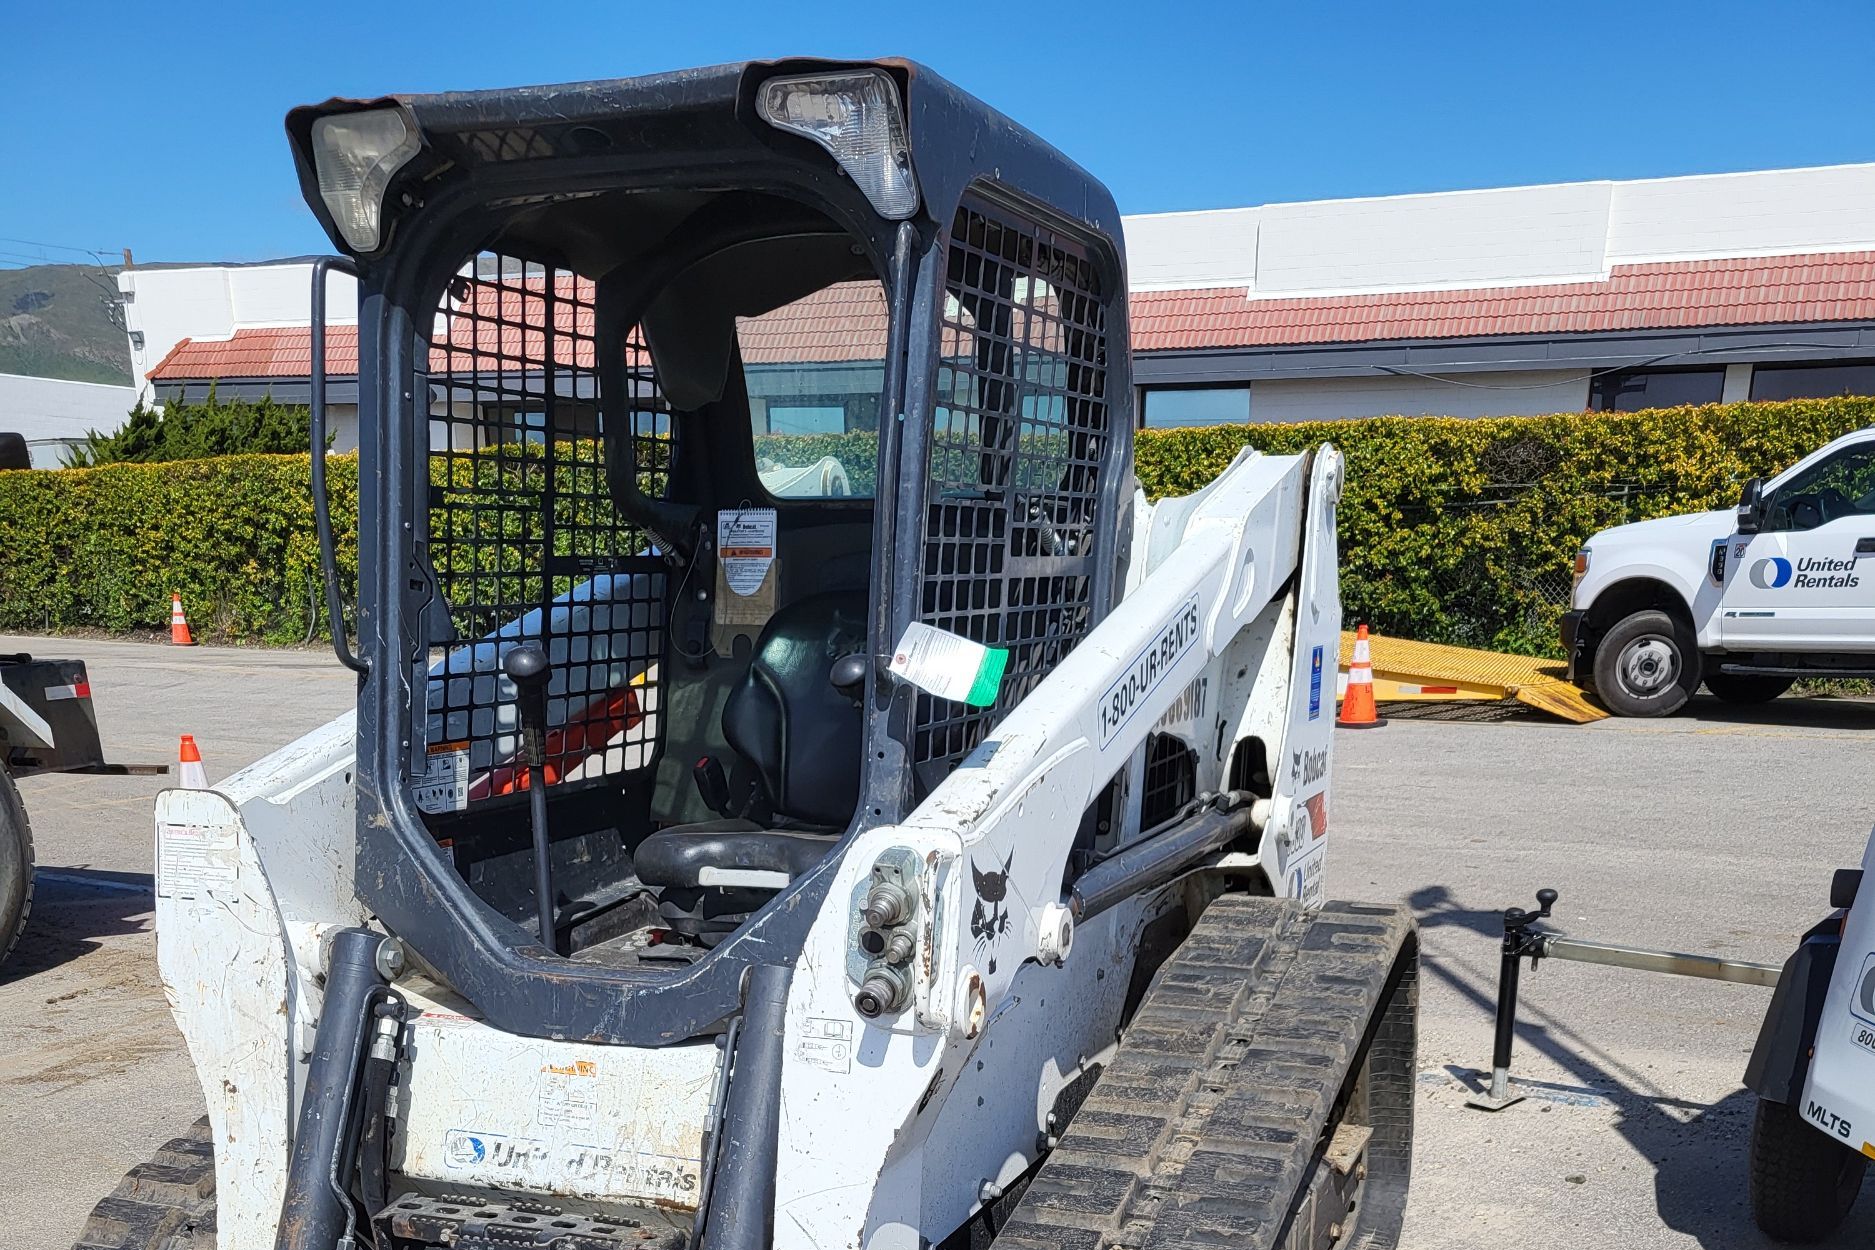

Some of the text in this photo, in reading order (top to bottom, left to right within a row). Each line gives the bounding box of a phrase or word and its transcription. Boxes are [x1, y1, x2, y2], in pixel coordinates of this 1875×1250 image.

[1797, 556, 1858, 572] United
[1794, 573, 1860, 588] Rentals
[1101, 603, 1198, 738] 1-800-UR-RENTS
[1806, 1100, 1852, 1138] MLTS
